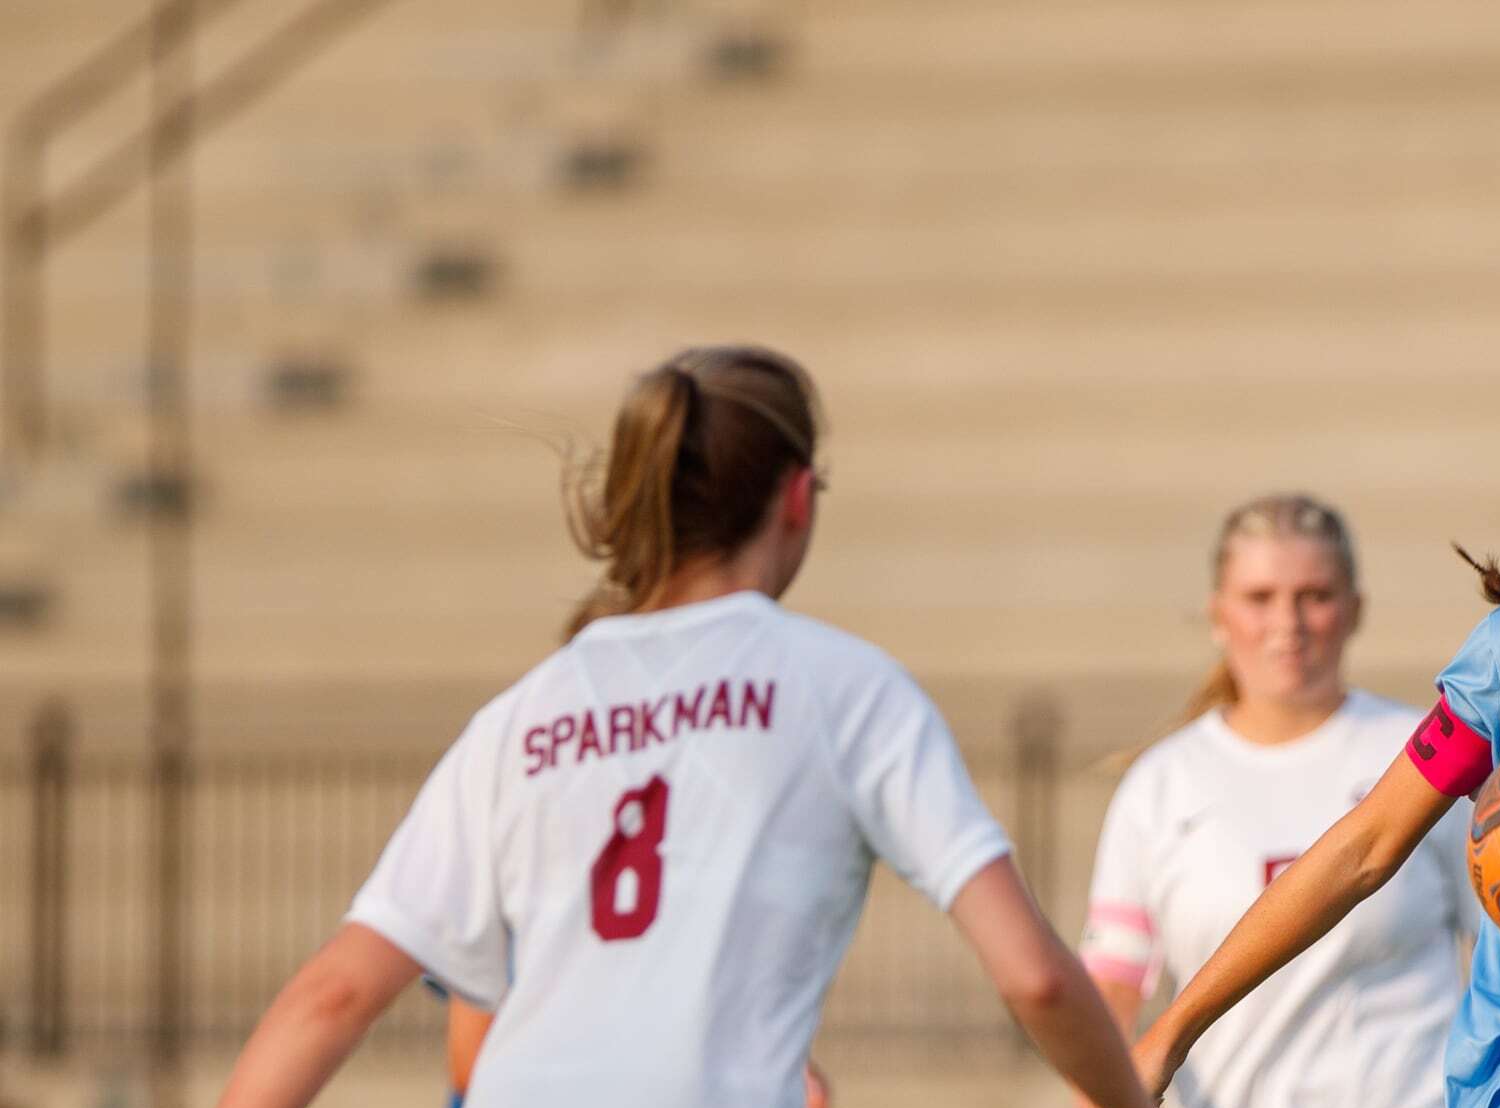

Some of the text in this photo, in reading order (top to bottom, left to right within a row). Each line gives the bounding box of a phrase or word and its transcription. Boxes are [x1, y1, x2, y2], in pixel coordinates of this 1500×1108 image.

[524, 678, 776, 778] SPARKMAN
[1411, 701, 1455, 761] C
[589, 774, 669, 942] 8
